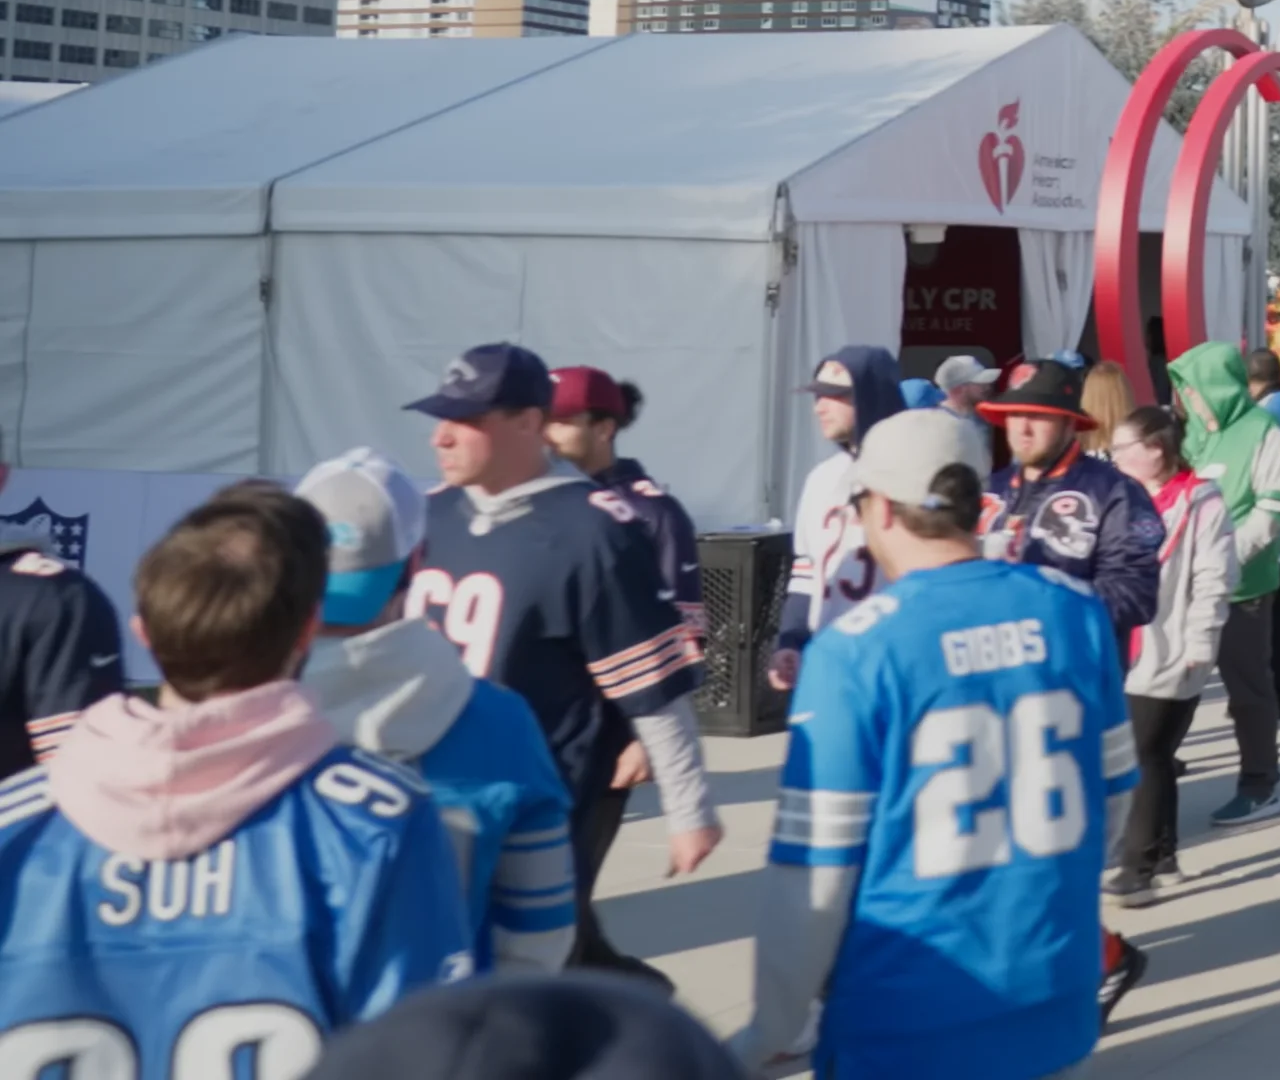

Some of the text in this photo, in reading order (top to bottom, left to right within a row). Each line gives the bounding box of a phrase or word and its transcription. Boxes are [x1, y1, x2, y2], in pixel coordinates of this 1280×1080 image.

[943, 287, 998, 312] CPR
[941, 618, 1046, 676] GIBBS
[910, 687, 1087, 880] 26
[98, 838, 236, 926] SUH
